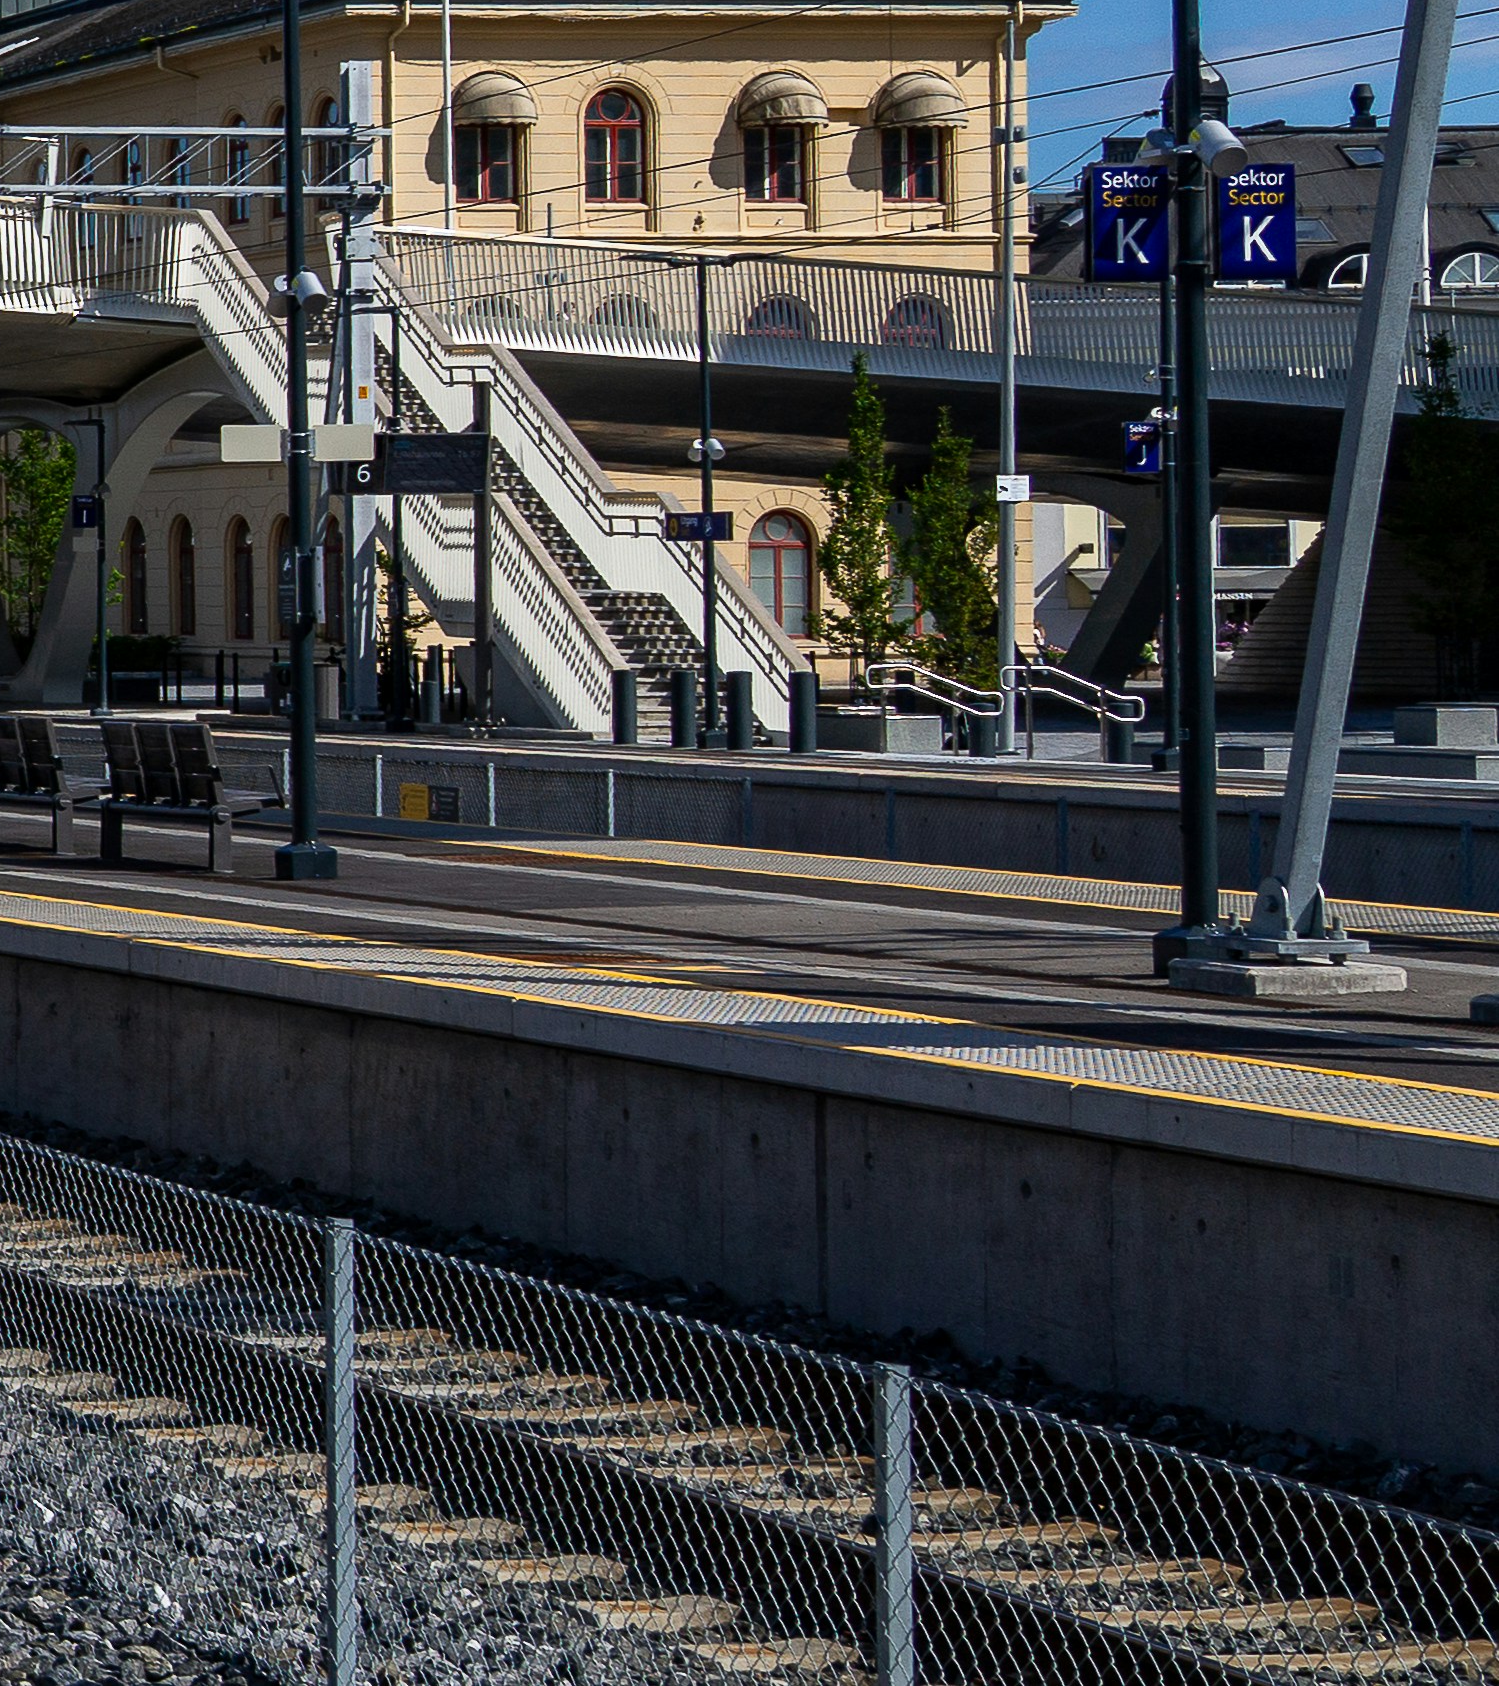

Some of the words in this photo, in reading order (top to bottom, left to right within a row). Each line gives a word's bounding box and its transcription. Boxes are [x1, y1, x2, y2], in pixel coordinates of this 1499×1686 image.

[1101, 171, 1159, 188] Sektor
[1227, 169, 1286, 187] Sektor
[1101, 190, 1159, 208] Sector
[1228, 189, 1285, 206] Sector
[1116, 218, 1150, 264] K
[1242, 215, 1278, 262] K
[1136, 444, 1147, 465] J
[357, 464, 371, 482] 6
